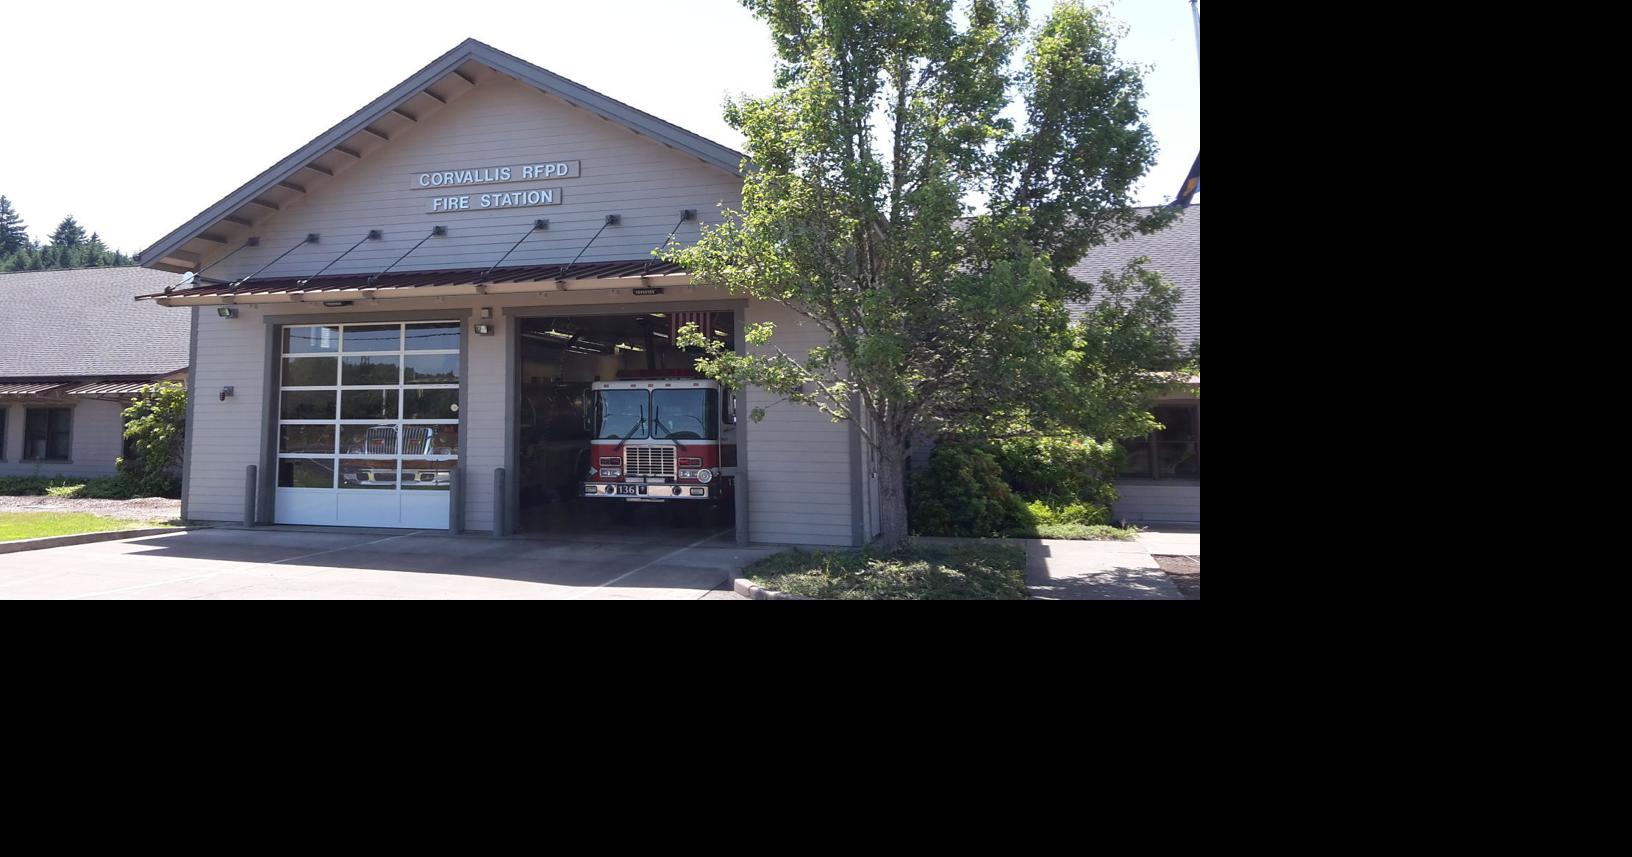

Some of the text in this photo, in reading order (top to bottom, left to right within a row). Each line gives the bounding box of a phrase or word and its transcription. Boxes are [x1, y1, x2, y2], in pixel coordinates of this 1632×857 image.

[420, 163, 568, 187] CORVALLIS RFPD
[433, 190, 553, 211] FIRE STATION
[618, 485, 635, 494] 136
